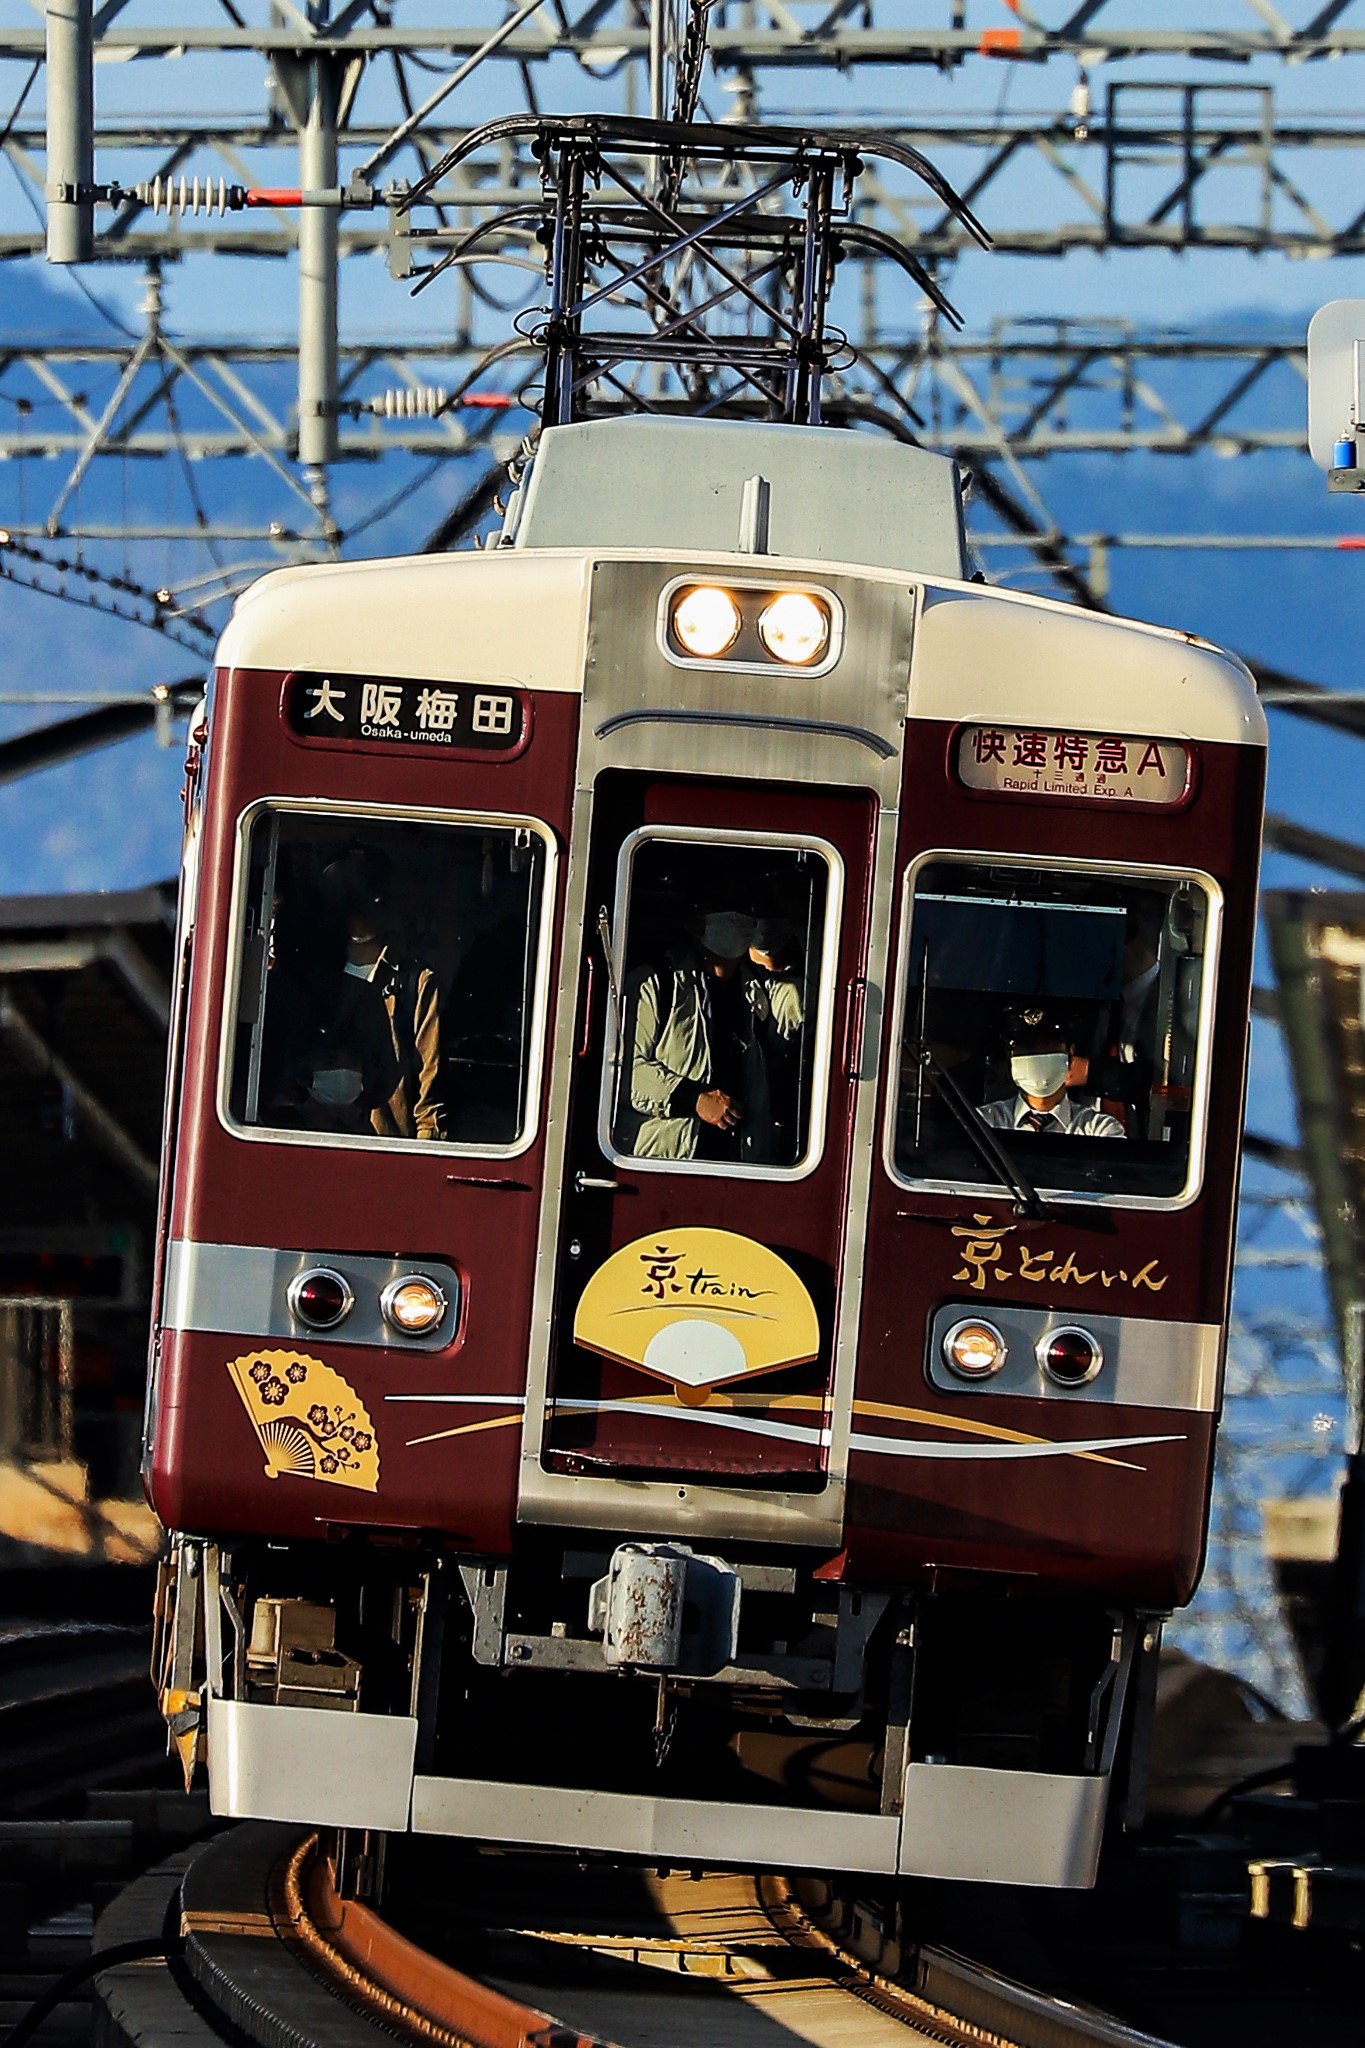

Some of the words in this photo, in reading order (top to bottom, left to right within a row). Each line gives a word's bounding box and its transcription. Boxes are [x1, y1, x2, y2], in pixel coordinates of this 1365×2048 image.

[304, 680, 513, 734] 大阪梅田
[1004, 778, 1038, 791] Rapid
[1044, 781, 1087, 794] Limited
[1094, 785, 1119, 797] Exp.
[1124, 787, 1133, 797] A
[951, 1213, 1168, 1291] 京とれいん
